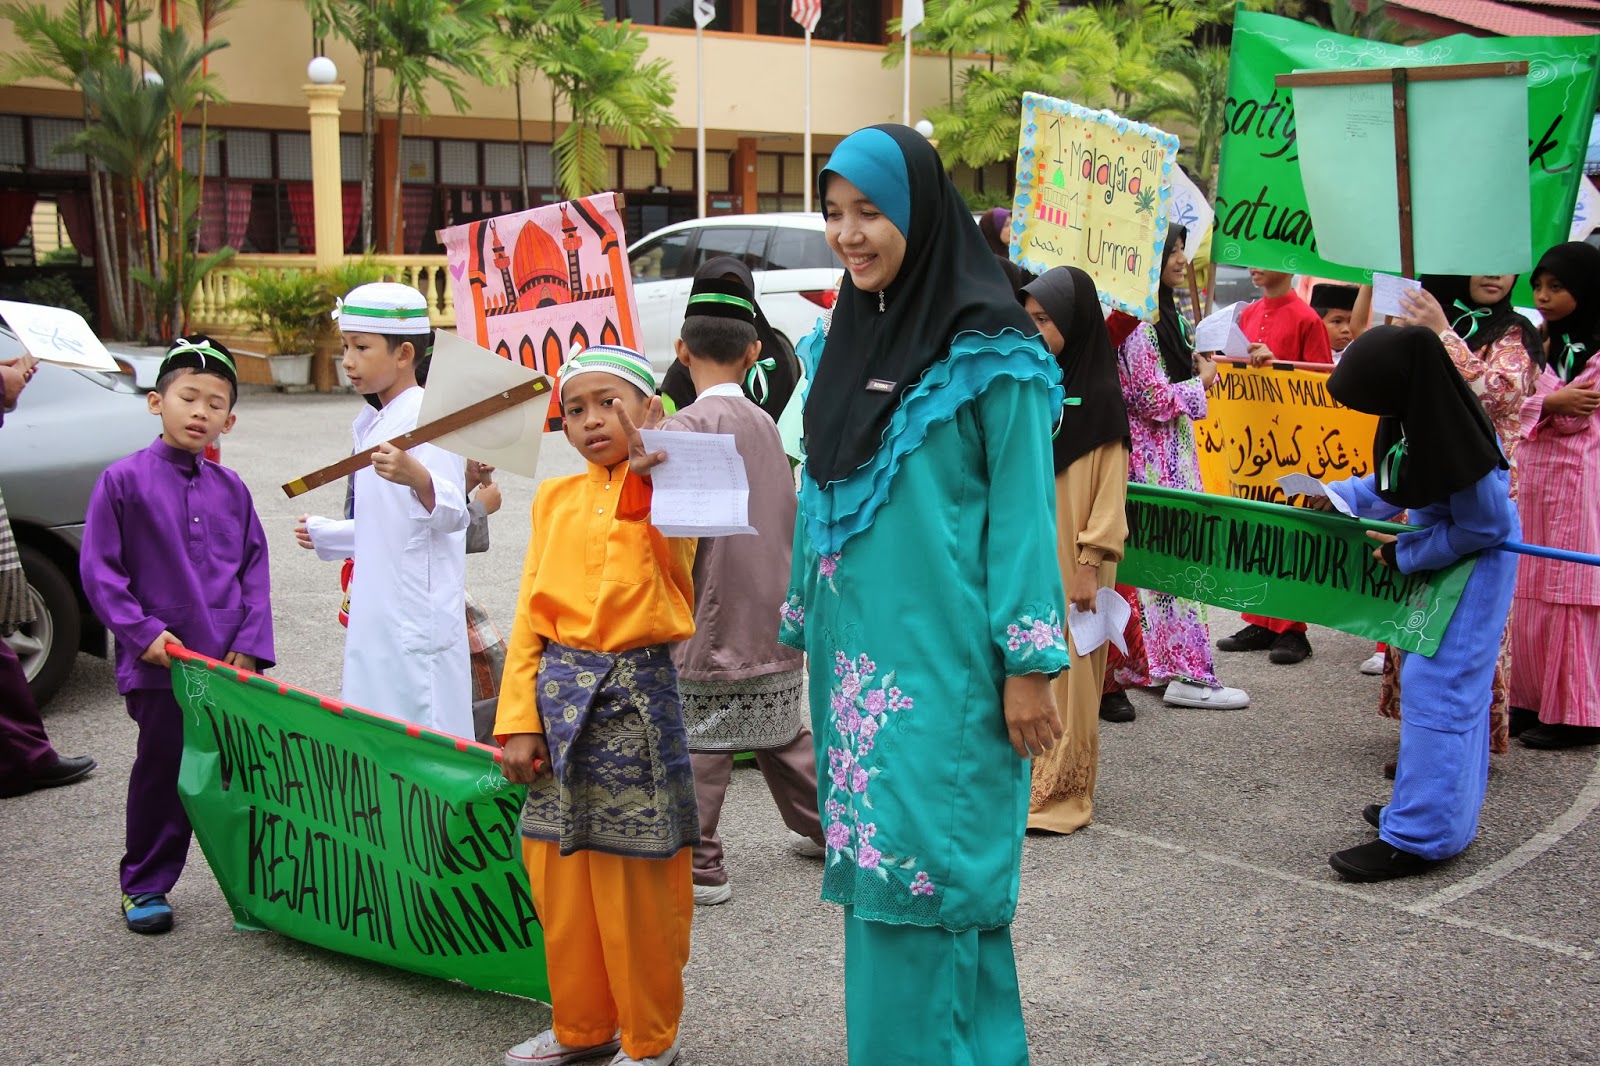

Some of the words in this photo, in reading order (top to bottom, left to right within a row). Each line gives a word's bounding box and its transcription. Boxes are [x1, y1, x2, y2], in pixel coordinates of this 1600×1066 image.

[1069, 140, 1142, 205] Malaysia
[1087, 227, 1142, 277] Ummah
[1225, 518, 1349, 592] MAULIDUR
[203, 705, 387, 851] WASATIYYAH
[248, 805, 397, 950] KESATUAN
